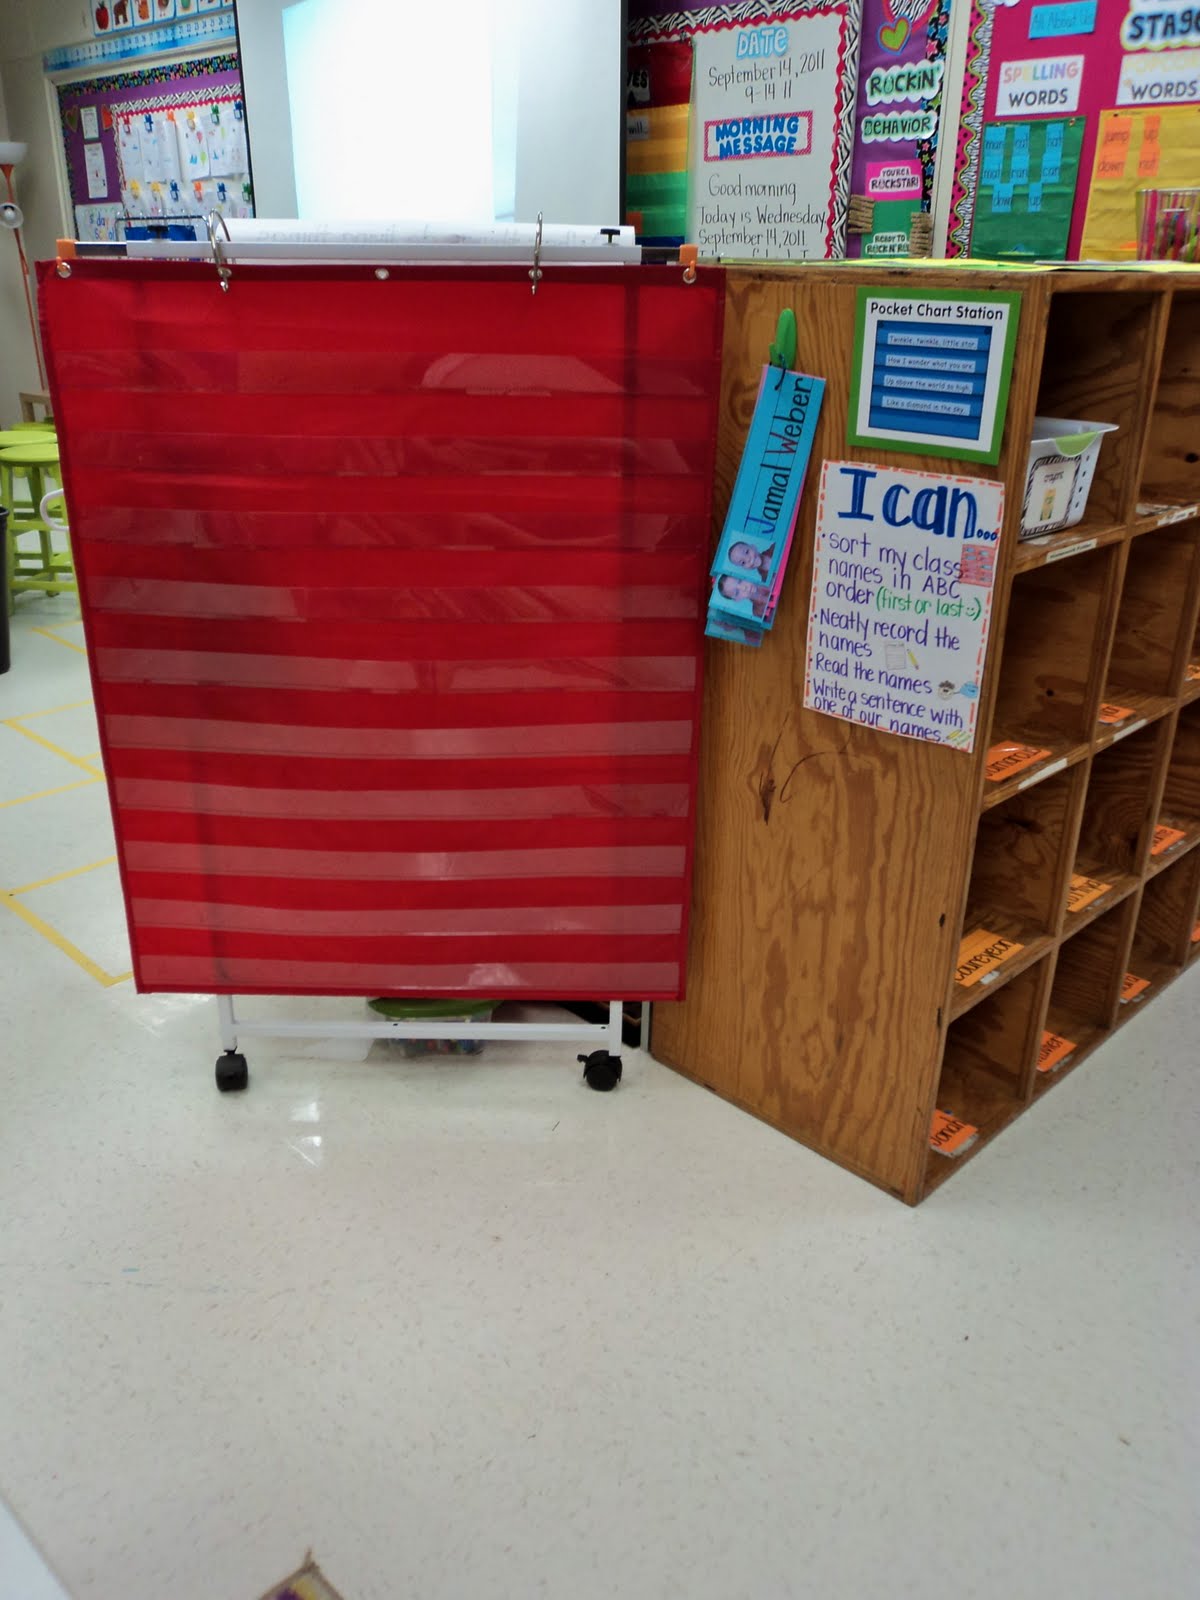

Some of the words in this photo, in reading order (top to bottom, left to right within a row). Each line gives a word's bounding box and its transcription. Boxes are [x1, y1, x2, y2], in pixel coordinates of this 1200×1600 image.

[709, 62, 776, 91] September
[1004, 61, 1079, 87] SPELLING
[1008, 88, 1068, 108] WORDS
[1131, 80, 1198, 101] WORDS
[715, 115, 799, 142] MORNING
[719, 134, 797, 160] MESSAGE
[709, 173, 742, 197] Good
[745, 182, 797, 206] morning
[697, 204, 736, 229] Today
[741, 211, 751, 224] is
[698, 225, 763, 253] September
[870, 302, 912, 315] Pocket
[917, 303, 952, 318] Chart
[956, 305, 1003, 320] Station
[888, 356, 900, 364] How
[908, 359, 930, 367] wonder
[765, 378, 811, 455] Weber
[744, 463, 791, 534] Jamal
[838, 467, 877, 521] I
[829, 558, 883, 585] names
[893, 568, 911, 590] in
[922, 575, 961, 599] ABC
[879, 546, 907, 573] my
[913, 546, 964, 580] class
[826, 580, 875, 605] order
[876, 586, 912, 612] (first
[915, 600, 931, 615] or
[819, 631, 872, 657] names
[820, 608, 869, 641] Neatly
[874, 618, 929, 647] record
[934, 626, 961, 650] the
[815, 652, 848, 677] Read
[854, 661, 874, 682] the
[878, 669, 933, 694] names
[813, 678, 850, 701] Write
[861, 692, 926, 719] sentence
[930, 707, 963, 729] with
[814, 696, 836, 714] one
[842, 701, 856, 719] of
[859, 709, 883, 727] our
[890, 718, 946, 743] names.
